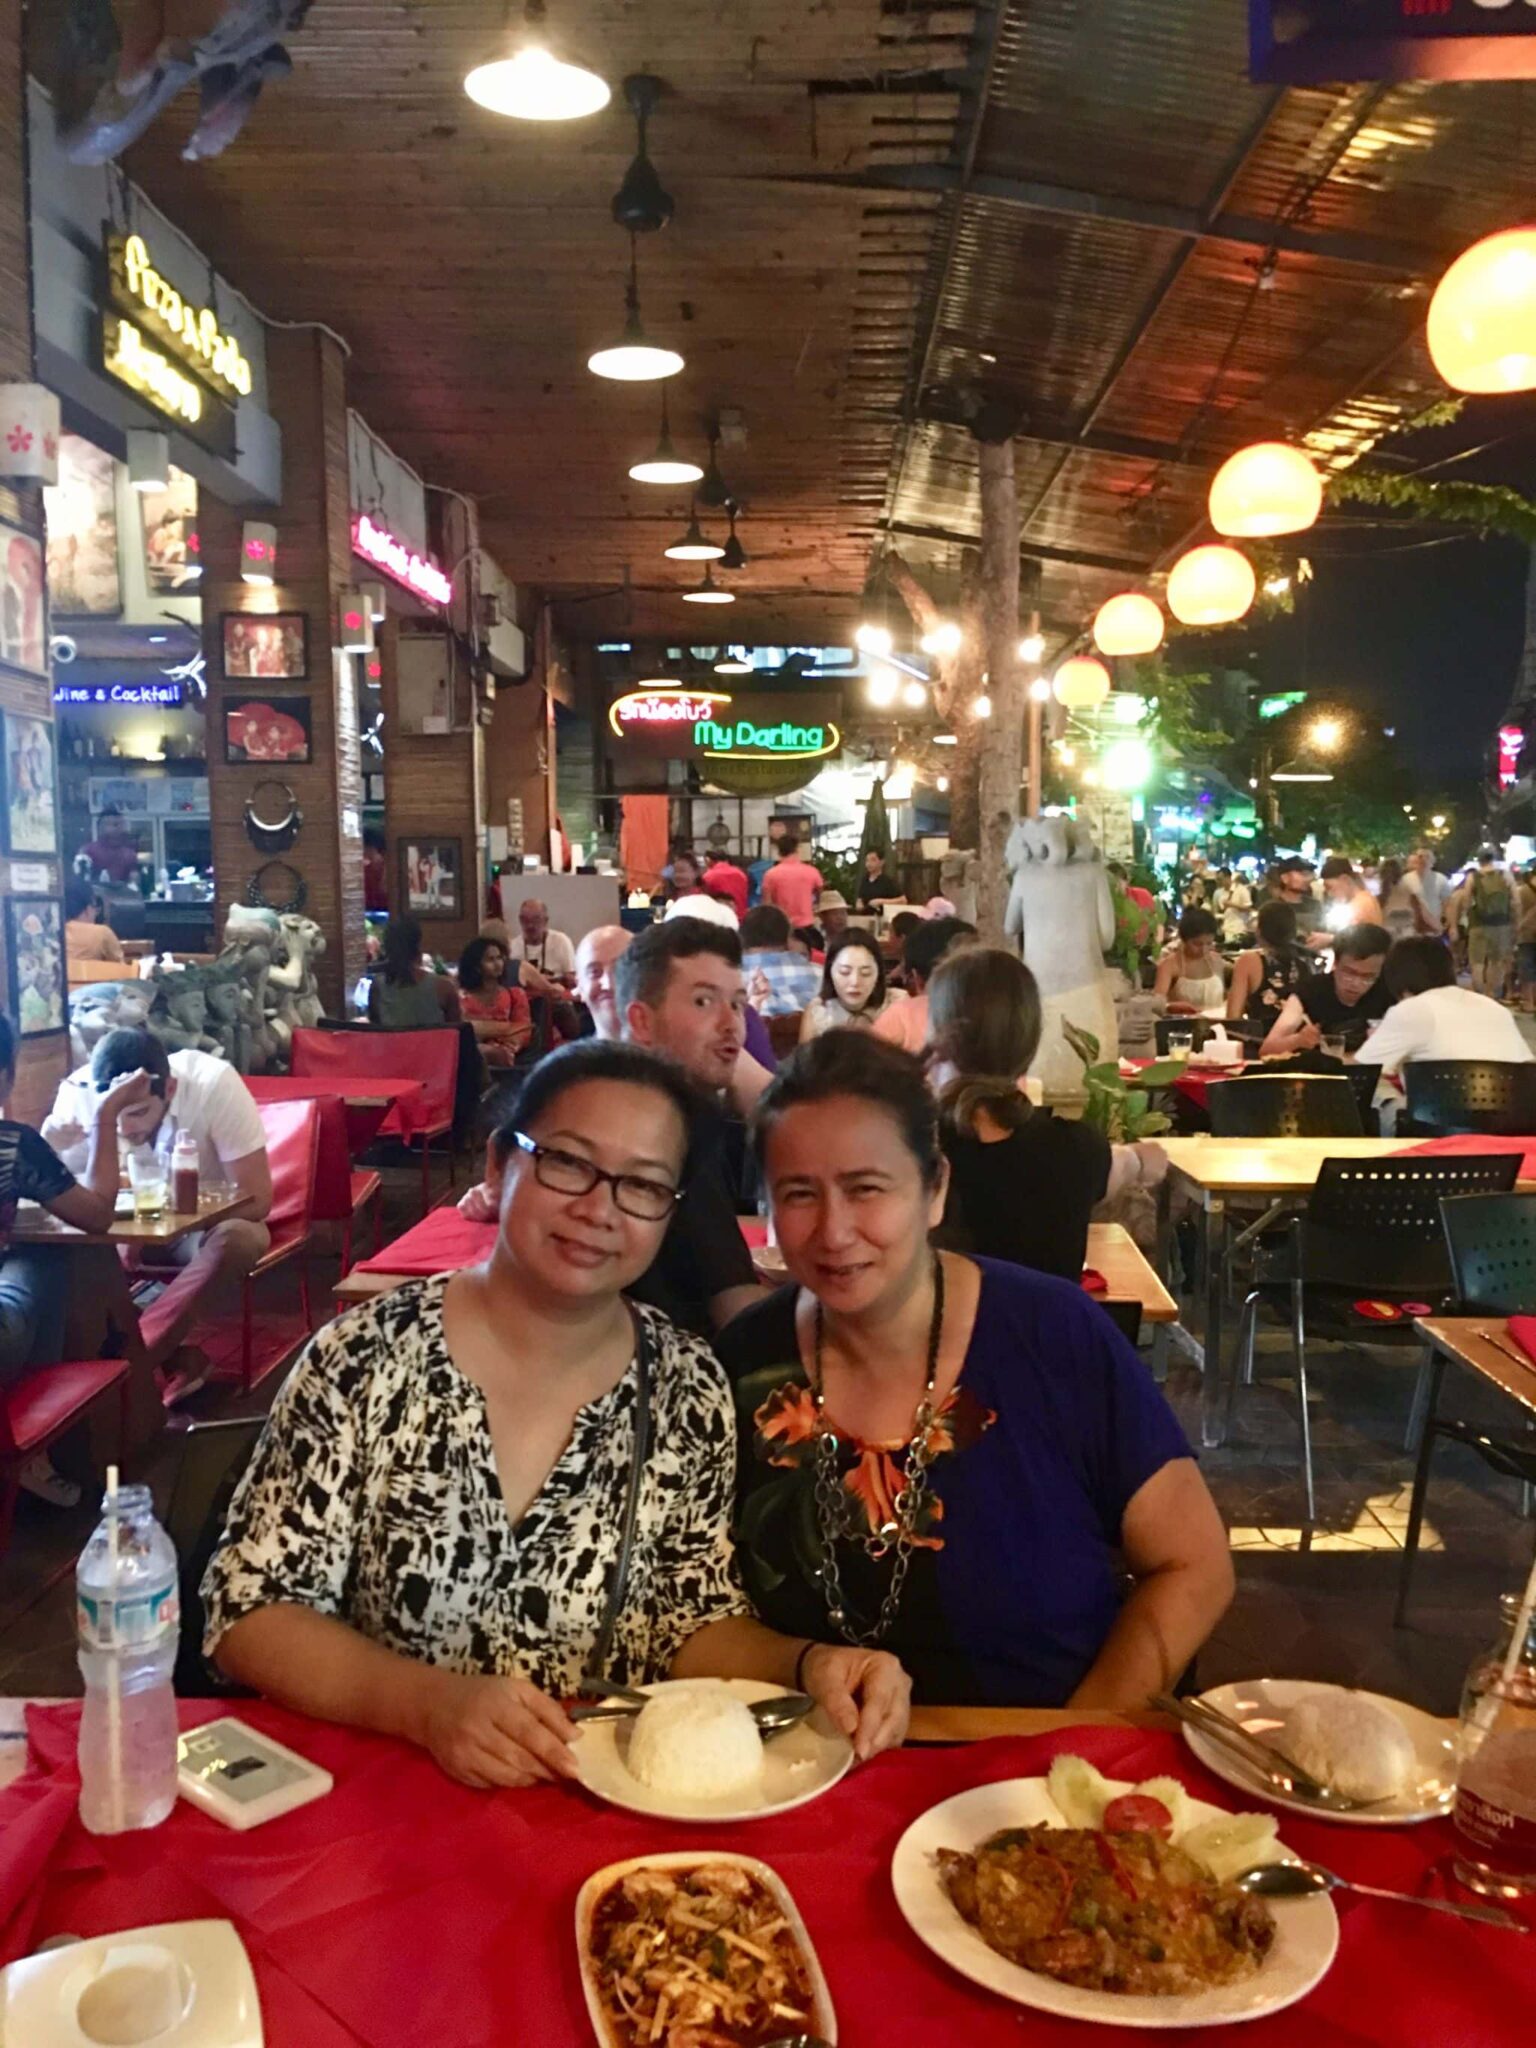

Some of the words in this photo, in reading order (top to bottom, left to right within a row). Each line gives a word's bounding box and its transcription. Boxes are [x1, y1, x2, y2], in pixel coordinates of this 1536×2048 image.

[111, 685, 179, 702] Cocktail
[694, 721, 732, 750] My
[736, 721, 823, 750] Darling
